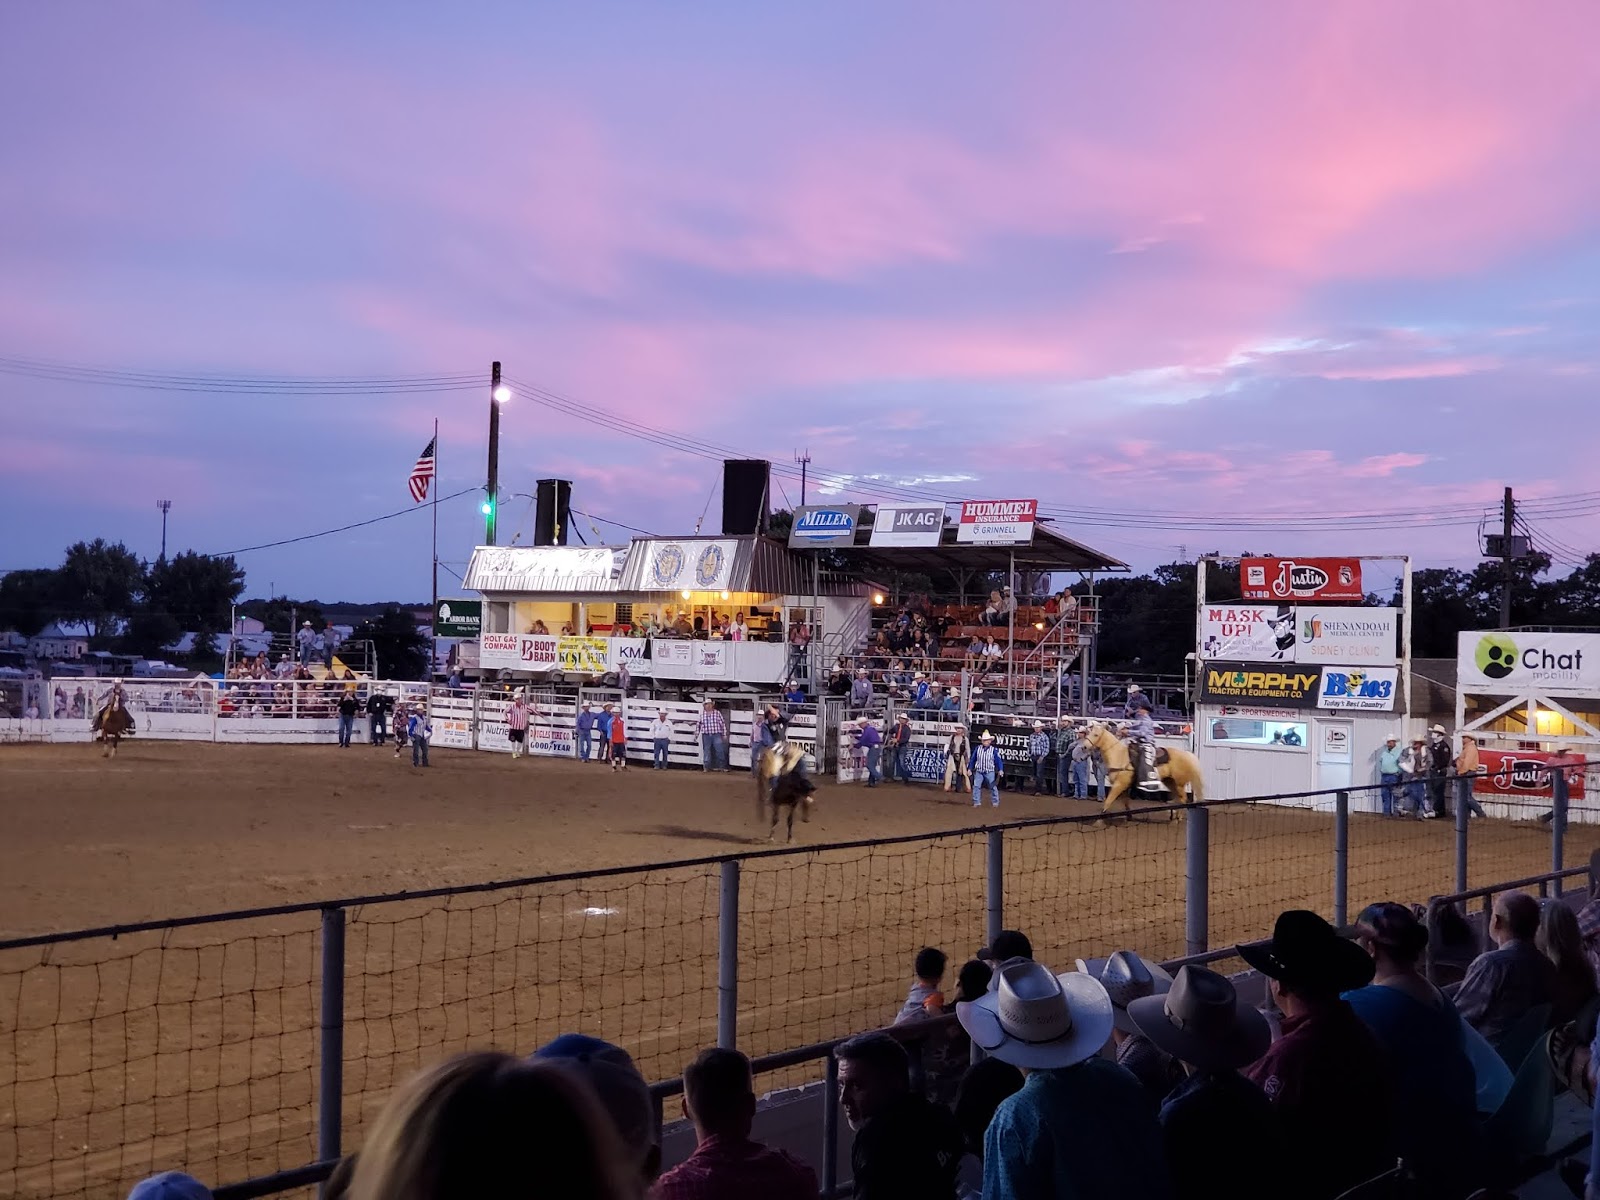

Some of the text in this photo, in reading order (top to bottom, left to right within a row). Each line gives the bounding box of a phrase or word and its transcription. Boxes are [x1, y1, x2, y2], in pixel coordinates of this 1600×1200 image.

[964, 501, 1033, 516] HUMMEL
[800, 511, 849, 526] MILLER
[896, 512, 935, 526] JK AG
[974, 515, 1020, 523] INSURANCE
[981, 526, 1017, 534] GRINNELL
[1272, 561, 1324, 597] Justin
[1208, 608, 1265, 623] MASK
[1221, 623, 1252, 637] UP!
[1323, 621, 1390, 631] SHENANDOAH
[484, 635, 502, 643] HOLT
[484, 642, 517, 651] COMPANY
[534, 641, 557, 652] BOOT
[1311, 645, 1380, 657] SIDNEY CLINIC
[534, 652, 556, 663] BARN
[1521, 648, 1583, 670] Chat
[1208, 670, 1319, 691] MURPHY
[1532, 671, 1581, 682] mobility
[1208, 686, 1303, 699] TRACTOR & EQUIPMENT CO.
[1357, 680, 1392, 698] 103
[1360, 701, 1386, 709] Country!
[1241, 708, 1296, 718] SPORTSMEDICINE
[486, 725, 509, 736] Nutrie
[912, 749, 944, 758] FIRST
[998, 747, 1033, 762] YBRID
[907, 765, 946, 774] NSURANCE
